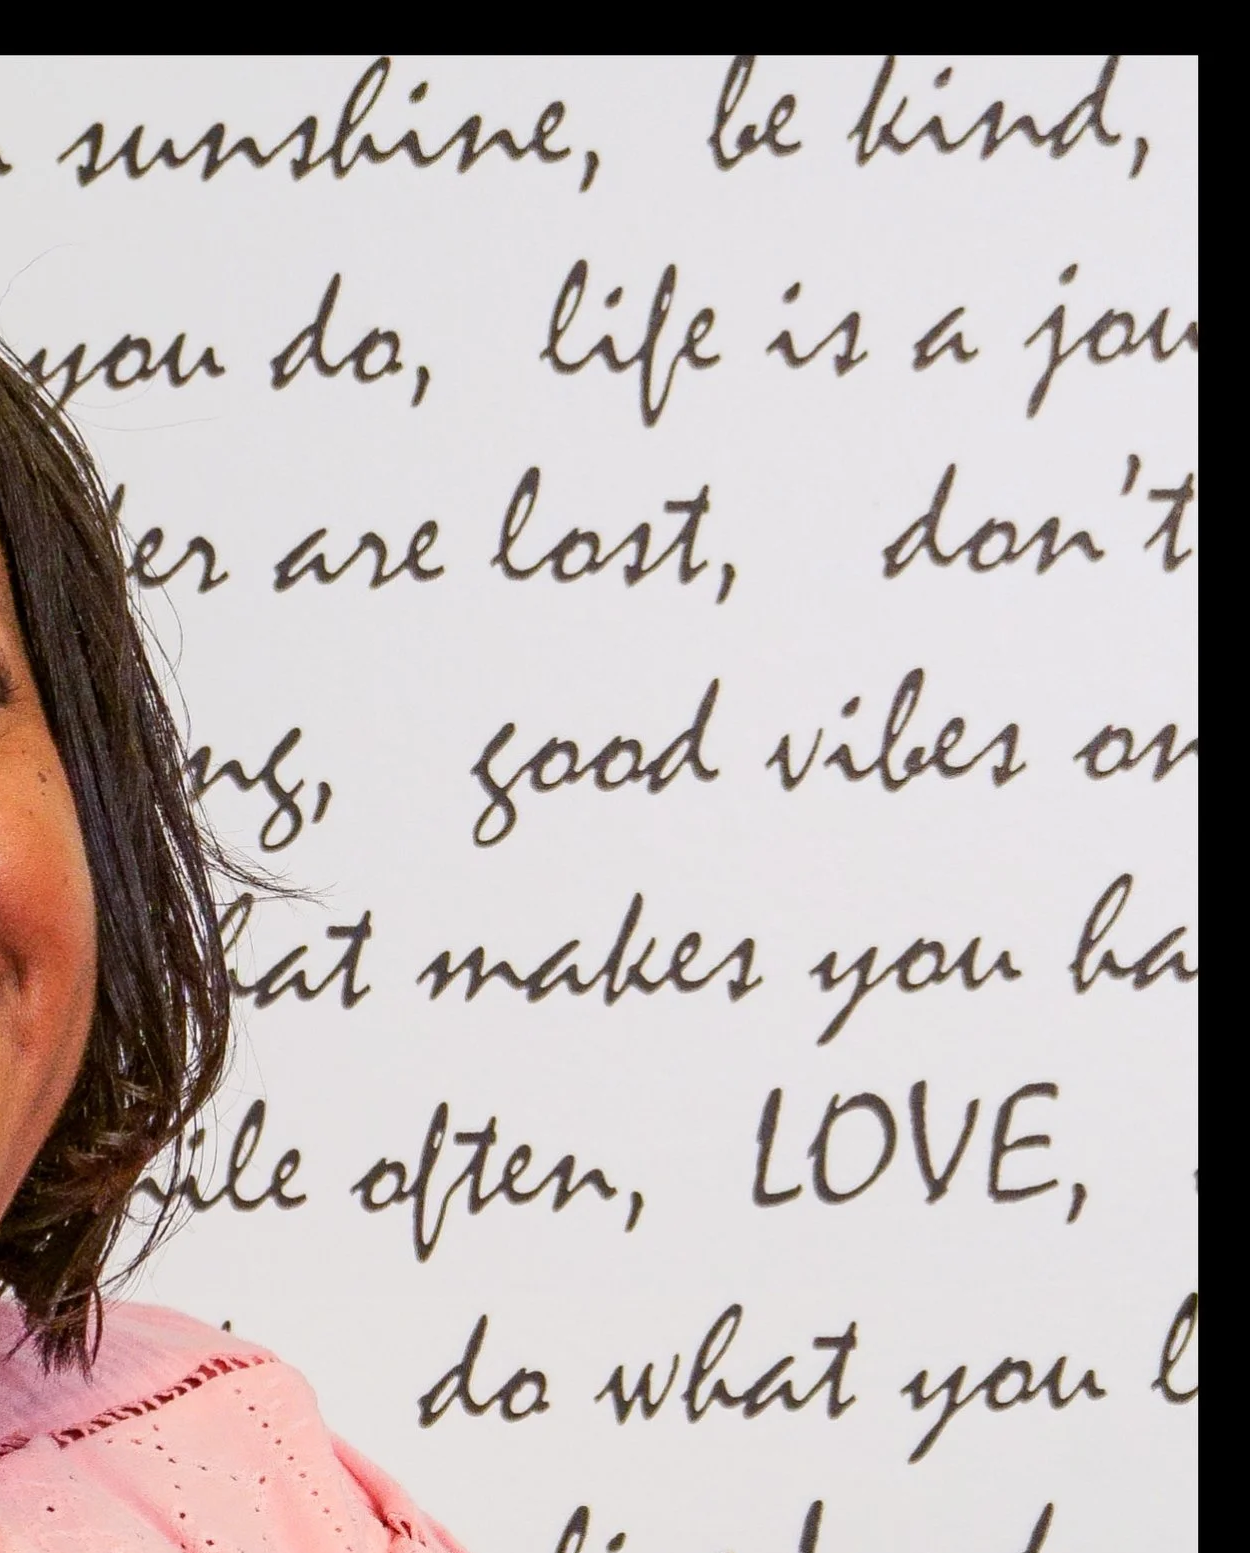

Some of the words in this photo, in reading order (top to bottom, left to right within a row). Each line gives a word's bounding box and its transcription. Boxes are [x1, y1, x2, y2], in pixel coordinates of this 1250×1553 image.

[57, 55, 600, 192] sunshine,
[708, 55, 802, 171] be
[849, 55, 1150, 178] kind,
[26, 332, 226, 411] you
[270, 272, 431, 407] do,
[539, 258, 721, 427] life
[766, 281, 869, 376] is
[913, 306, 979, 370] a
[273, 519, 445, 592] are
[491, 465, 736, 603] lost,
[882, 453, 1195, 579] don't
[470, 677, 720, 848] good
[765, 667, 1027, 792] vibes
[416, 891, 764, 1006] makes
[809, 936, 1023, 1046] you
[1069, 872, 1198, 994] ha
[350, 1101, 644, 1263] often,
[752, 1079, 1087, 1224] LOVE,
[418, 1313, 551, 1428] do
[594, 1302, 858, 1424] what
[900, 1355, 1107, 1463] you
